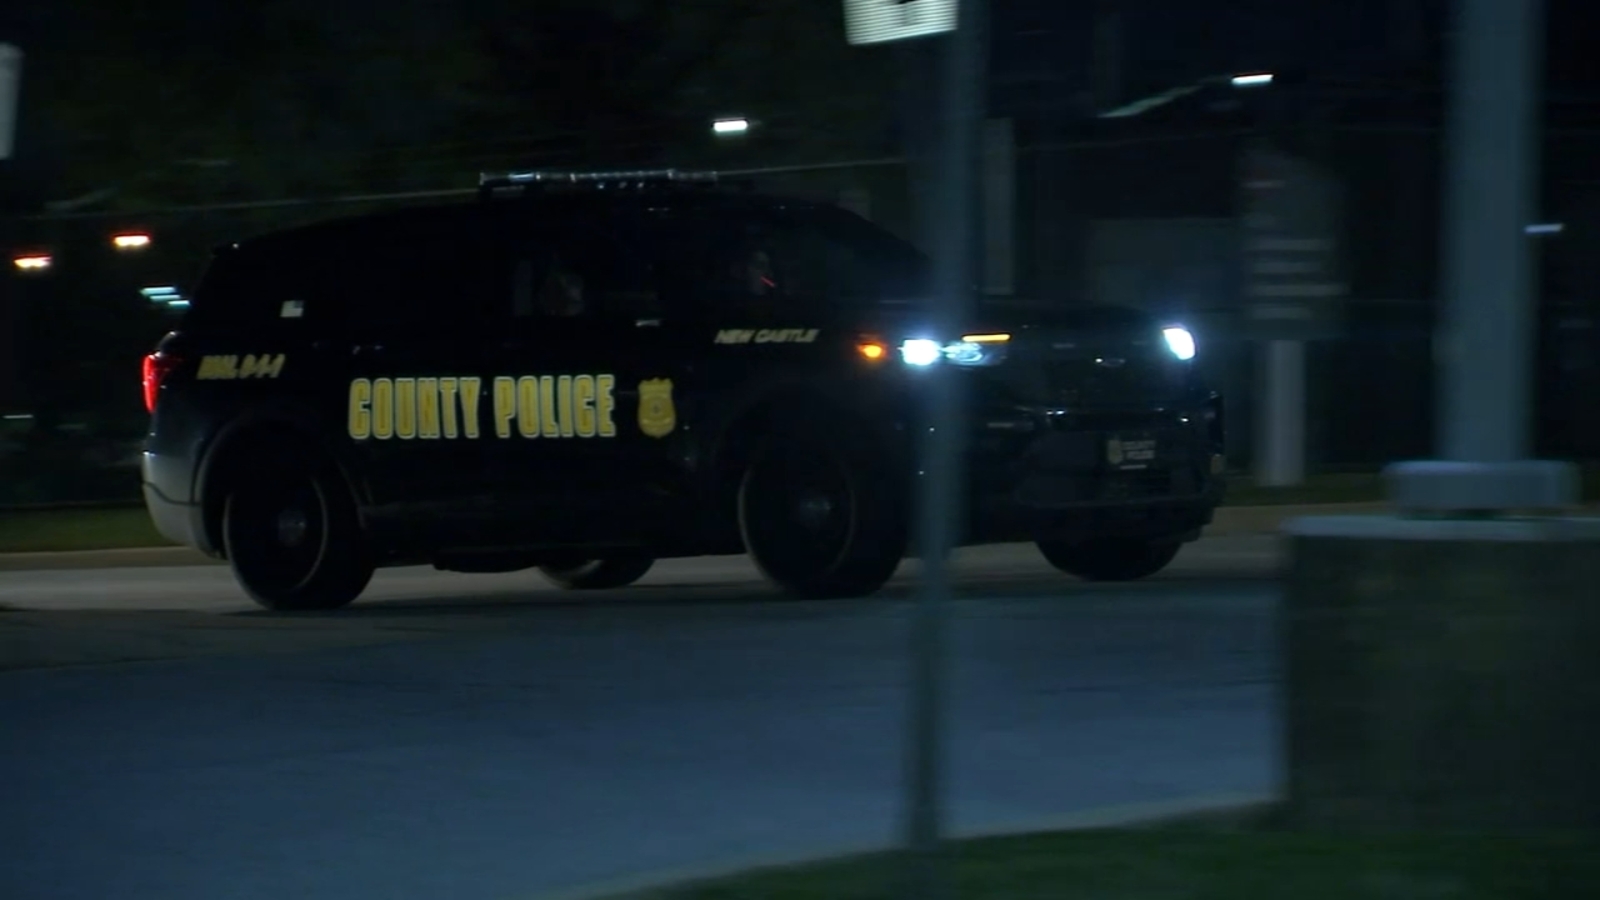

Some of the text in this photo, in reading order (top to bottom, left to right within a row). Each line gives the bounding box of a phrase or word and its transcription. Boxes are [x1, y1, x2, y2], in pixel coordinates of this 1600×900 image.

[714, 328, 820, 344] NEW CASTLE
[348, 376, 481, 440] COUNTY
[493, 374, 617, 439] POLICE
